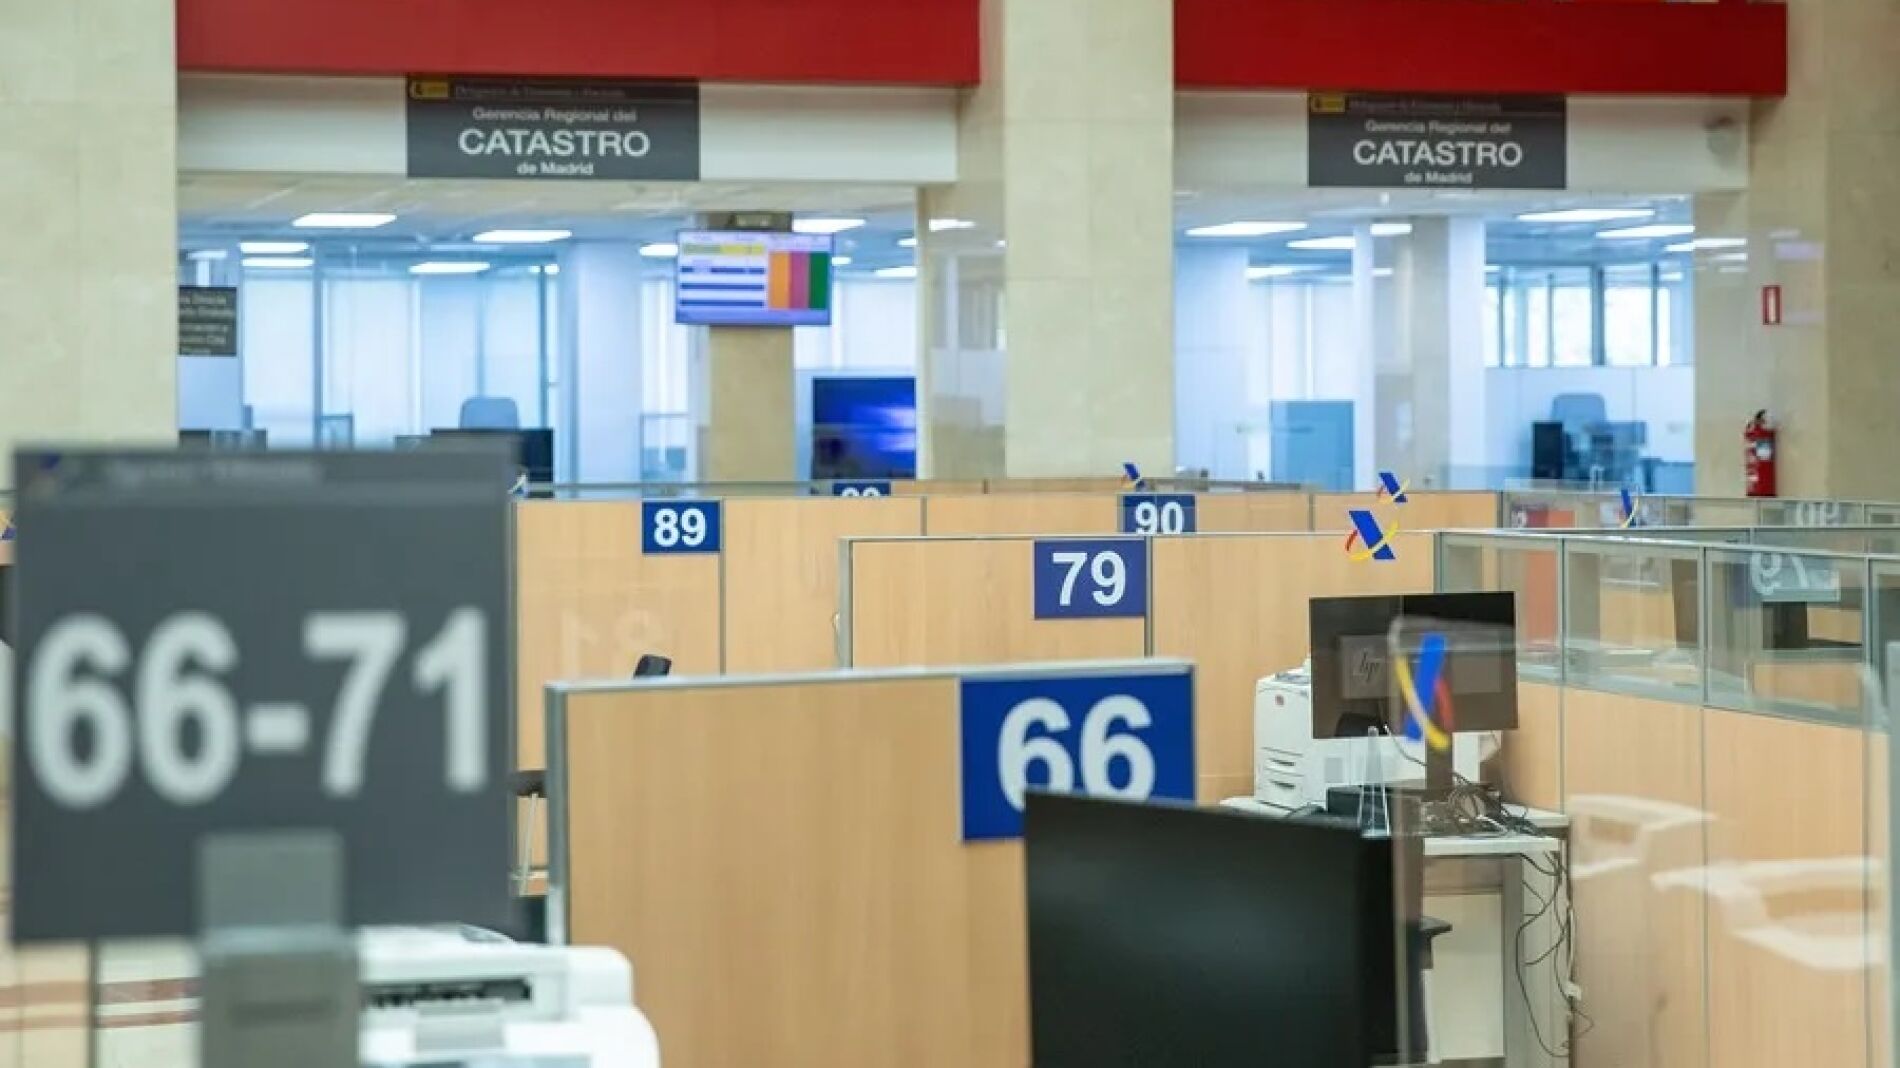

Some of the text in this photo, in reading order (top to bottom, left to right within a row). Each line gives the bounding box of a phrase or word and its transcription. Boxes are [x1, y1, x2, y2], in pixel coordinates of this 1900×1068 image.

[472, 107, 637, 124] Gerencia Regional del
[1365, 119, 1512, 135] Gerencia Regional del
[458, 128, 650, 158] CATASTRO
[1352, 139, 1523, 167] CATASTRO
[516, 161, 594, 176] de Madrid
[1403, 171, 1473, 185] de Madrid
[653, 507, 707, 547] 89
[1134, 501, 1184, 534] 90
[1052, 551, 1127, 607] 79
[27, 608, 489, 810] 66-71
[997, 694, 1156, 812] 66
